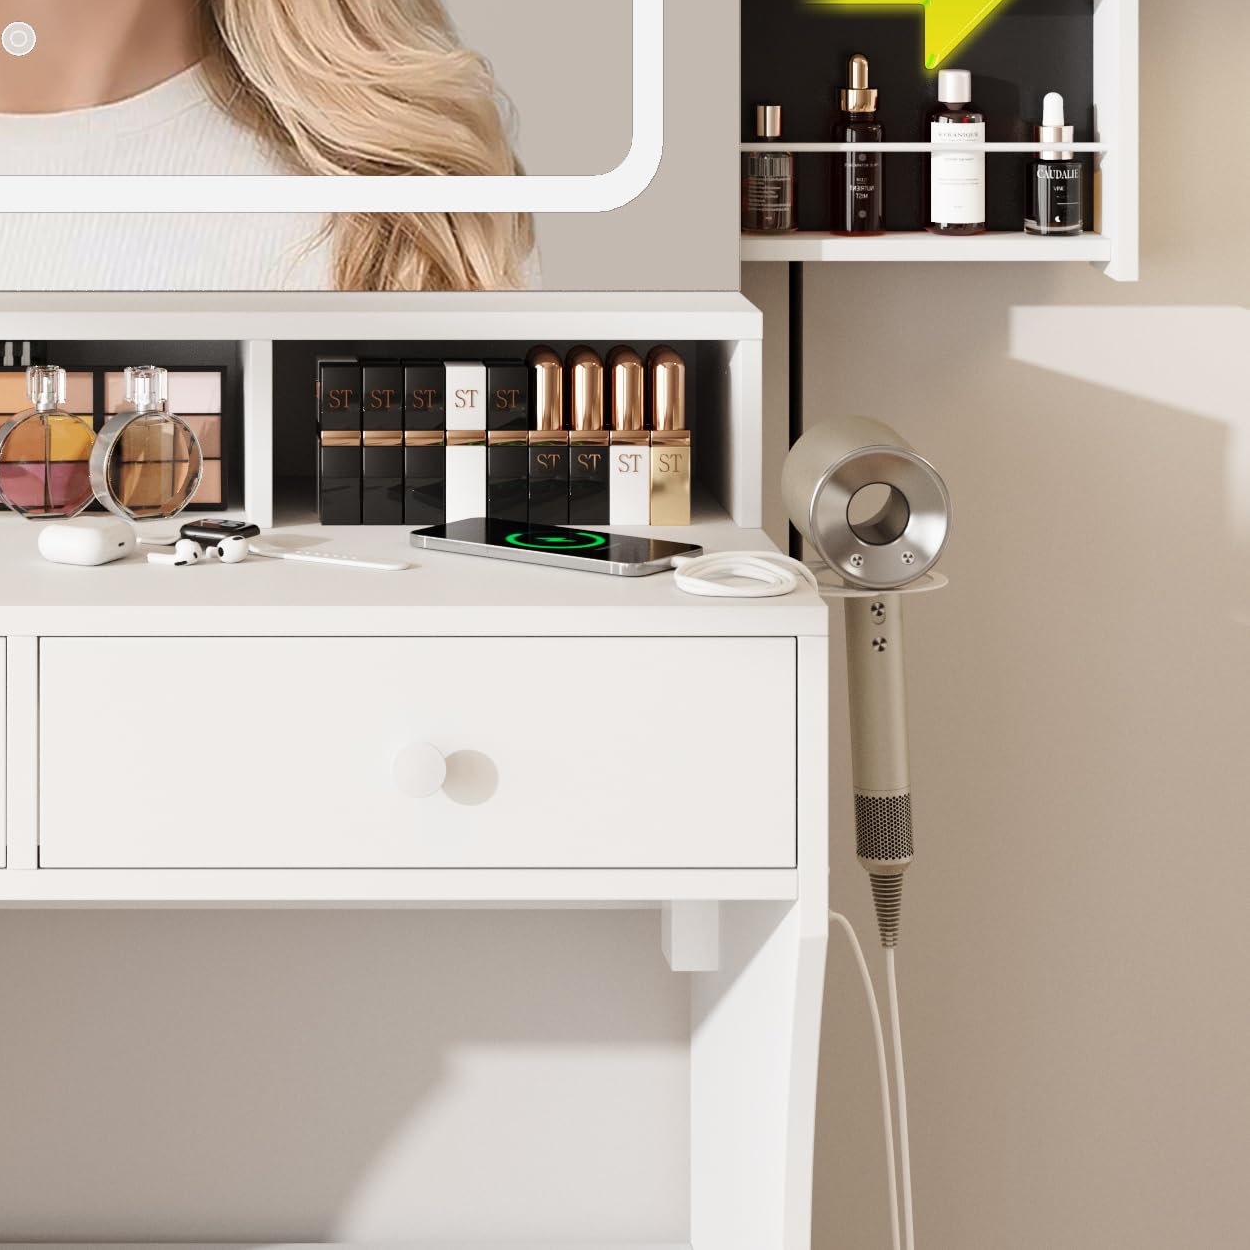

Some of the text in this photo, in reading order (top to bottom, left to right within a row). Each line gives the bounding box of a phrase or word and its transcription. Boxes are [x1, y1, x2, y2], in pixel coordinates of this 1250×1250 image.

[329, 389, 353, 409] ST
[370, 389, 395, 409] ST
[413, 389, 437, 409] ST
[454, 389, 479, 409] ST
[496, 389, 520, 409] ST
[618, 453, 643, 473] ST
[658, 453, 683, 473] ST
